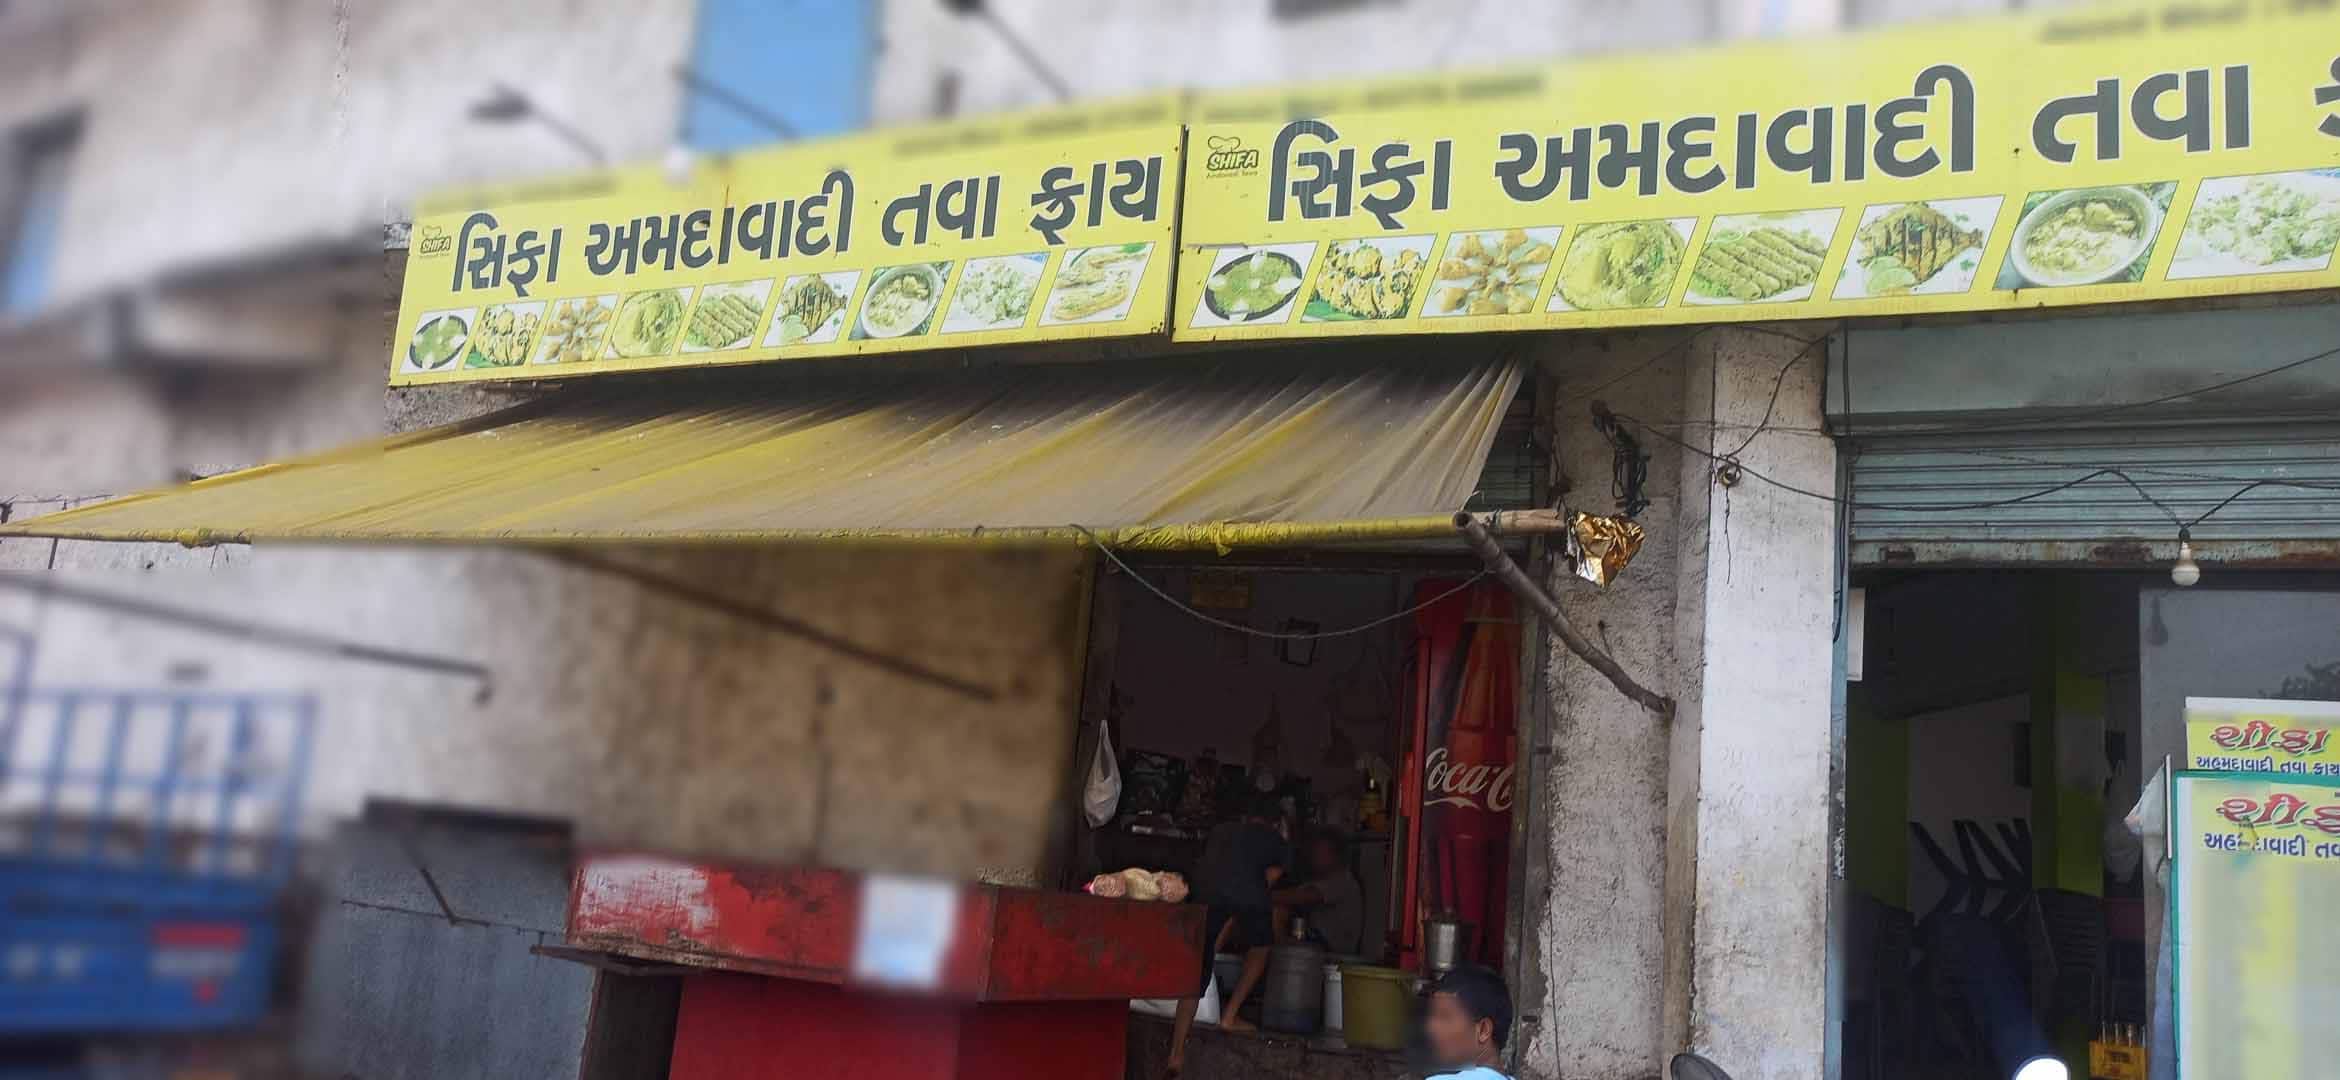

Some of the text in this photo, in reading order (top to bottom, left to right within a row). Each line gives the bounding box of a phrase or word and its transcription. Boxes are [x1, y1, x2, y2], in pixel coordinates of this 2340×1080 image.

[1207, 150, 1258, 170] SHIFA
[1268, 120, 1452, 230] સિફા
[1495, 65, 1974, 202] અમદાવાદી
[2033, 65, 2250, 163] તવા
[452, 212, 562, 298] સિફા
[585, 170, 854, 276] અમદાવાદી
[881, 175, 1001, 246] તવા
